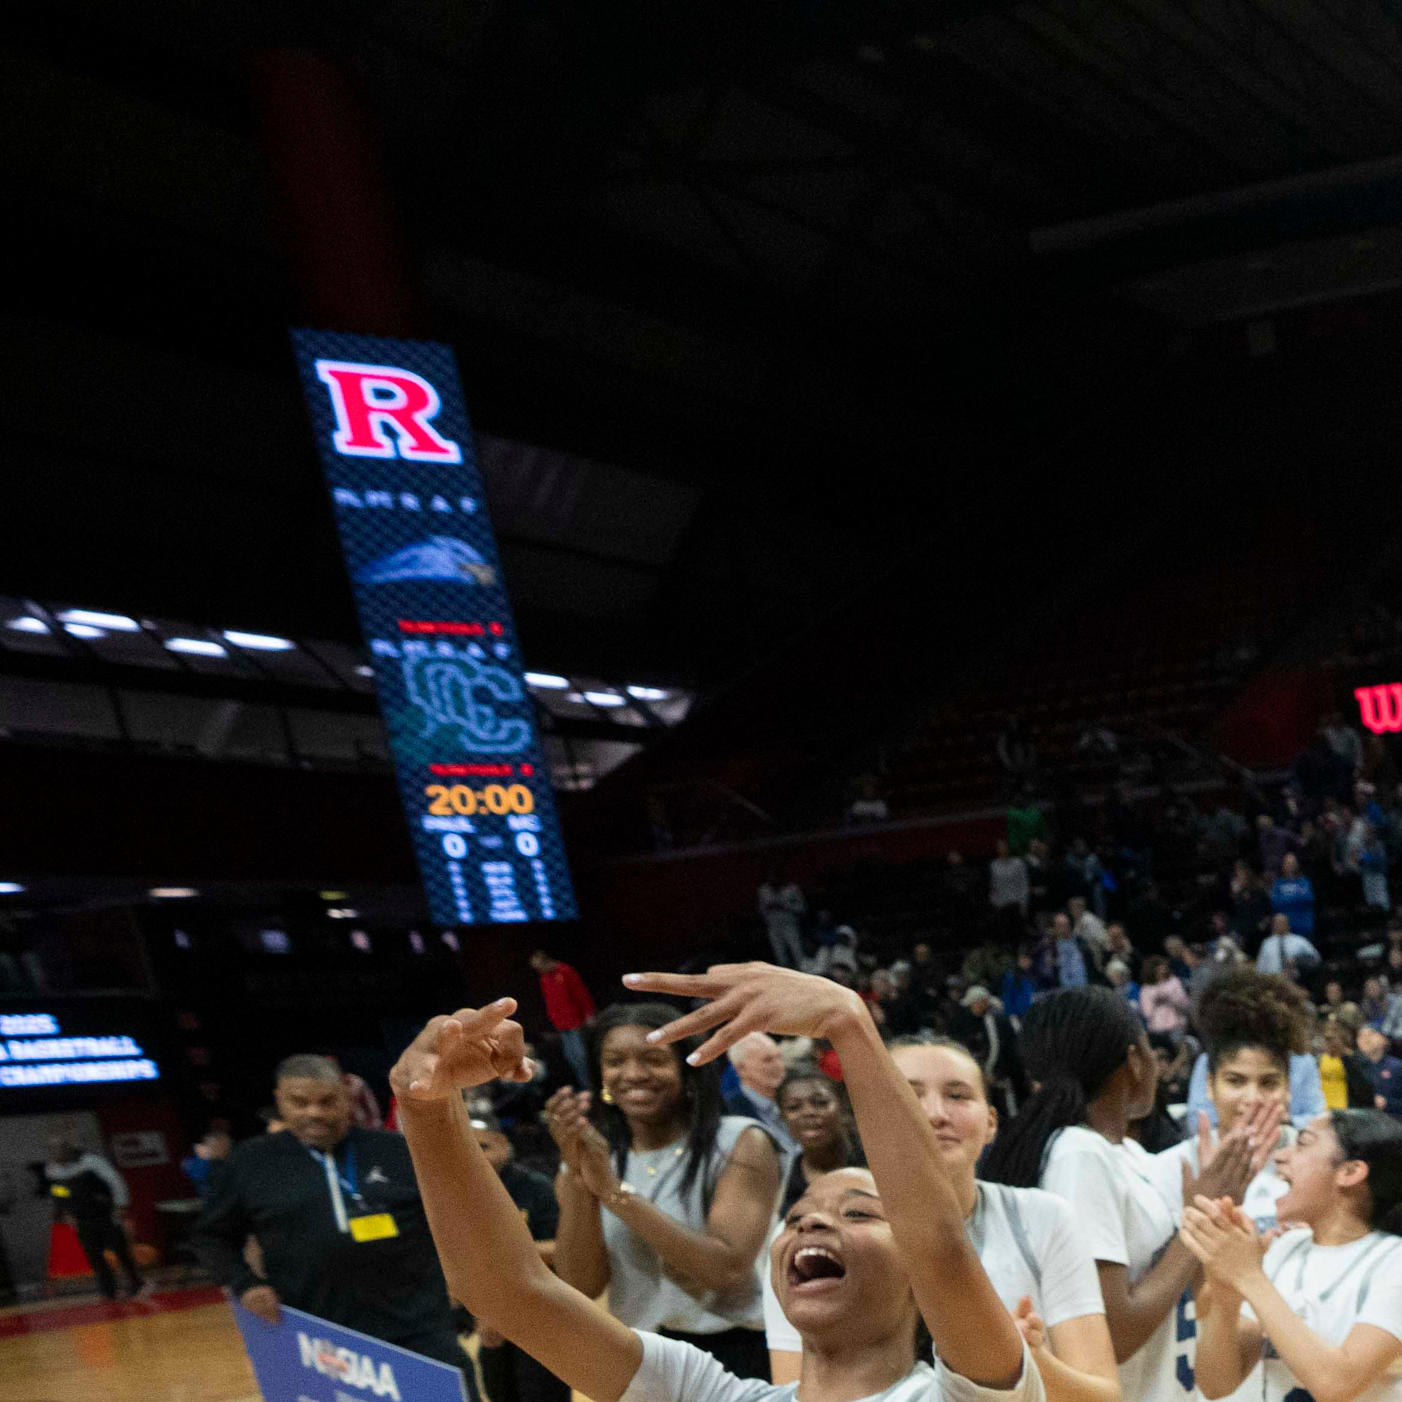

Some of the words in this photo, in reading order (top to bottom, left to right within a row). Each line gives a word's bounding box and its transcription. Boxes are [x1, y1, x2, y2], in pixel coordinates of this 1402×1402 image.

[314, 358, 464, 466] R
[425, 783, 534, 816] 20:00
[442, 832, 468, 859] 0
[515, 831, 540, 858] 0
